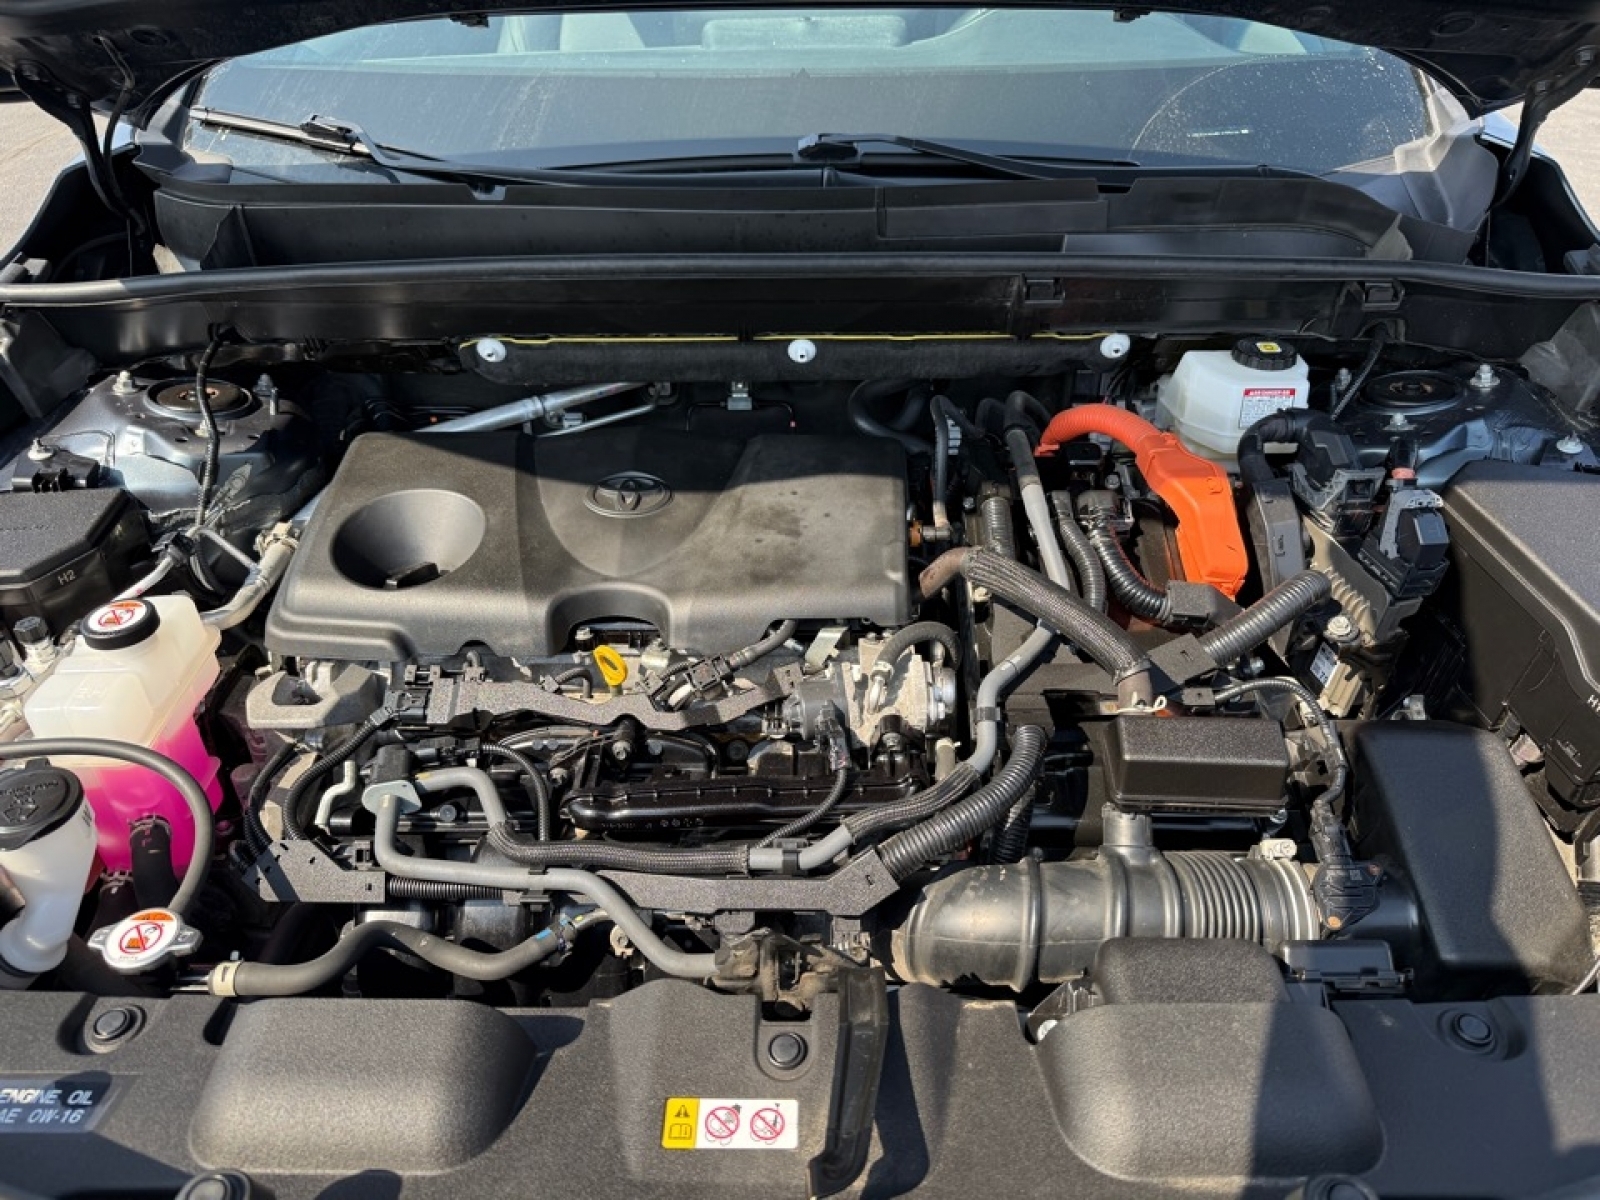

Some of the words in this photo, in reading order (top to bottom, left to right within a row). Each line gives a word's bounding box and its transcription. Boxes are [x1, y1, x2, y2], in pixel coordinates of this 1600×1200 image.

[0, 1088, 62, 1104] ENGINE
[67, 1089, 93, 1105] OIL
[27, 1108, 85, 1124] 0W-16
